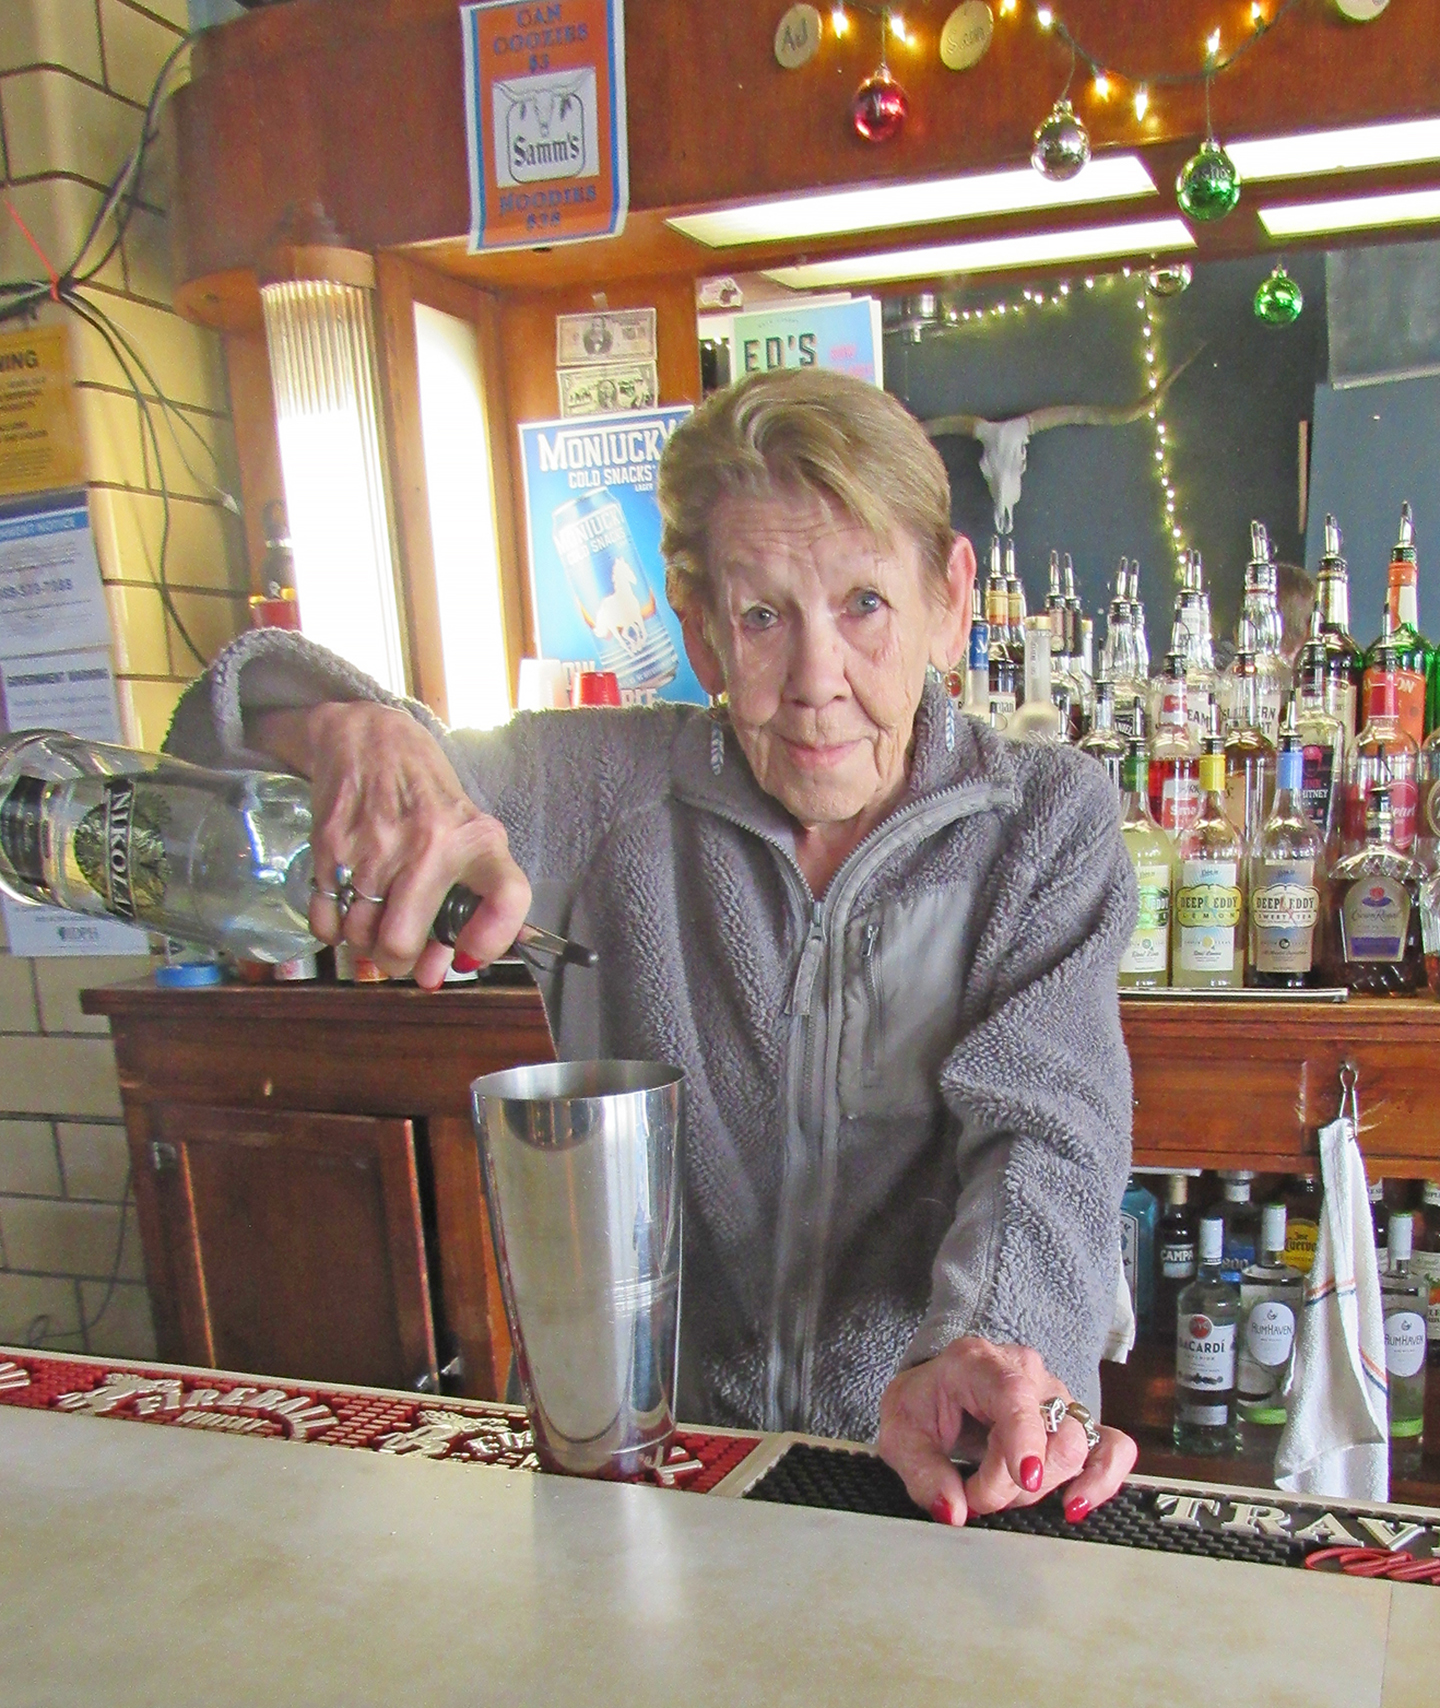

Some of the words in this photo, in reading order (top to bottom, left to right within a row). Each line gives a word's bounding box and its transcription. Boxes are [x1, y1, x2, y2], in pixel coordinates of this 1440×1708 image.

[517, 4, 561, 28] CAN
[494, 23, 588, 55] COOZIES
[513, 133, 580, 167] Samm's
[499, 184, 596, 217] HOODIES
[568, 470, 601, 489] COLD
[603, 464, 653, 486] SNACKS
[1180, 896, 1204, 909] DEEP
[1213, 896, 1238, 909] EDDY
[1256, 897, 1280, 910] DEEP
[1289, 897, 1315, 910] EDDY
[1156, 1493, 1440, 1558] TRAV
